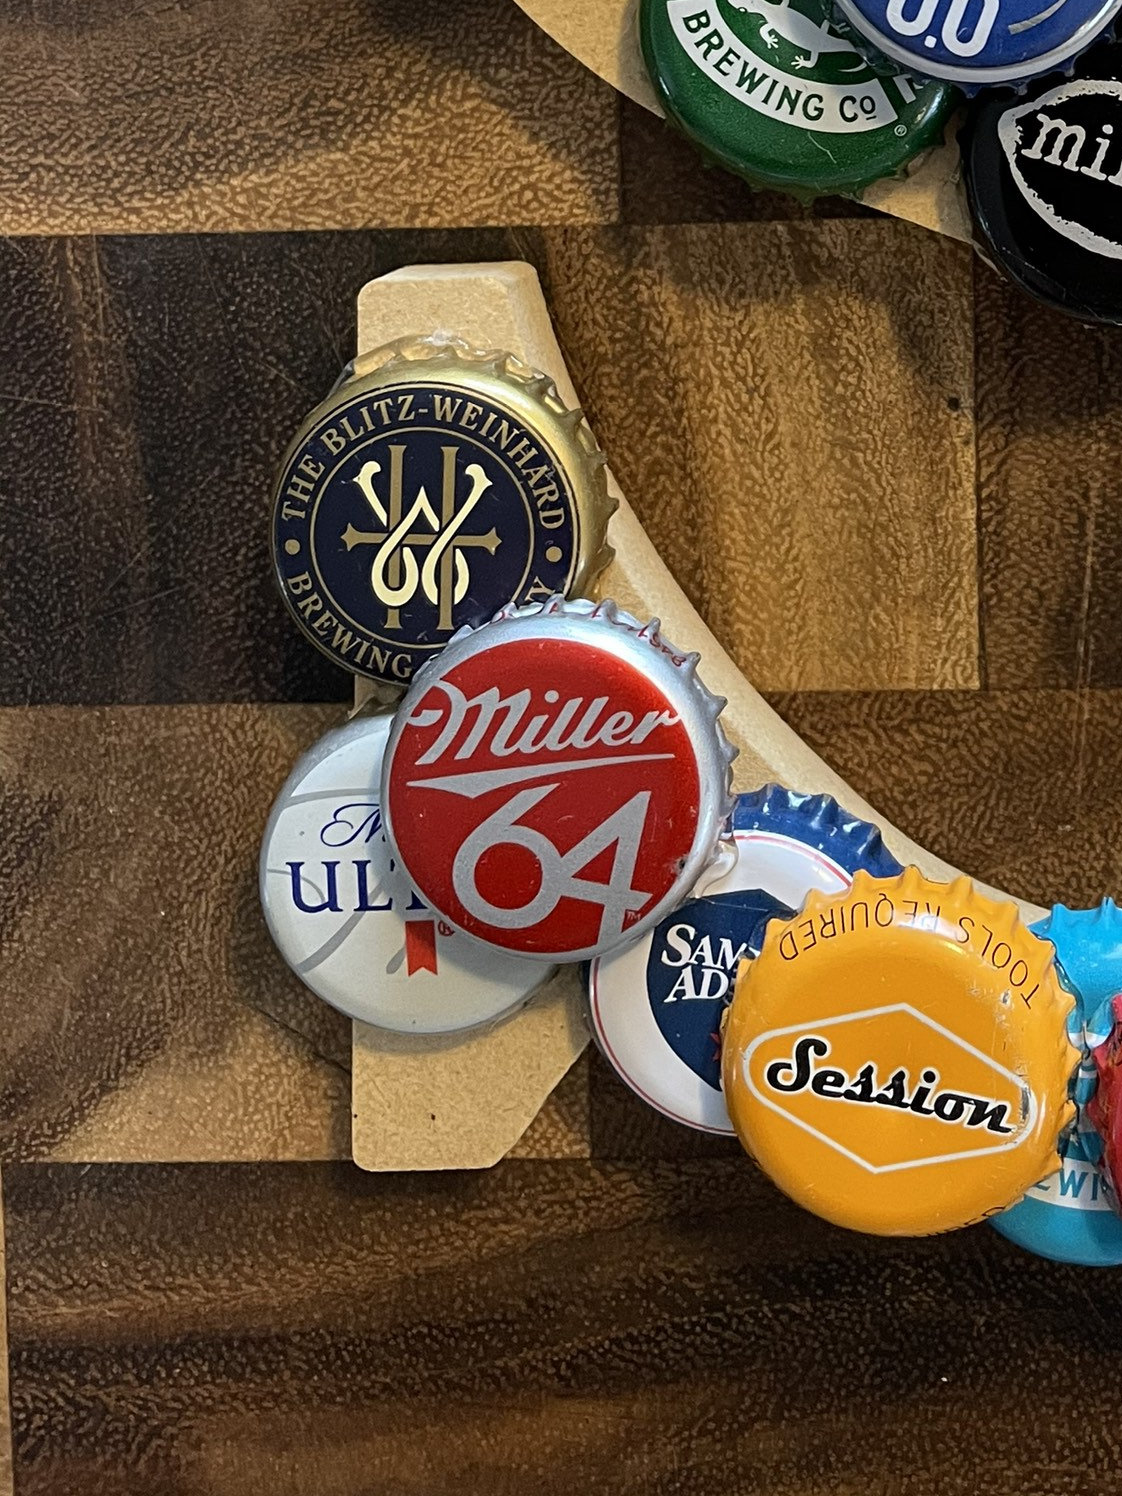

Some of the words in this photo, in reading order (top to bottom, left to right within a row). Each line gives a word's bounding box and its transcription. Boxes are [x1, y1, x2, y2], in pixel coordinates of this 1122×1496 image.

[682, 9, 824, 122] BREWING
[282, 454, 325, 522] THE
[320, 393, 566, 531] BLITZ-WEINHARD
[287, 571, 413, 679] BREWING
[406, 679, 682, 766] Miller
[452, 782, 654, 947] 64
[779, 892, 941, 961] REQUIRED
[957, 915, 1041, 1009] TOOLS
[765, 1037, 1016, 1133] Session
